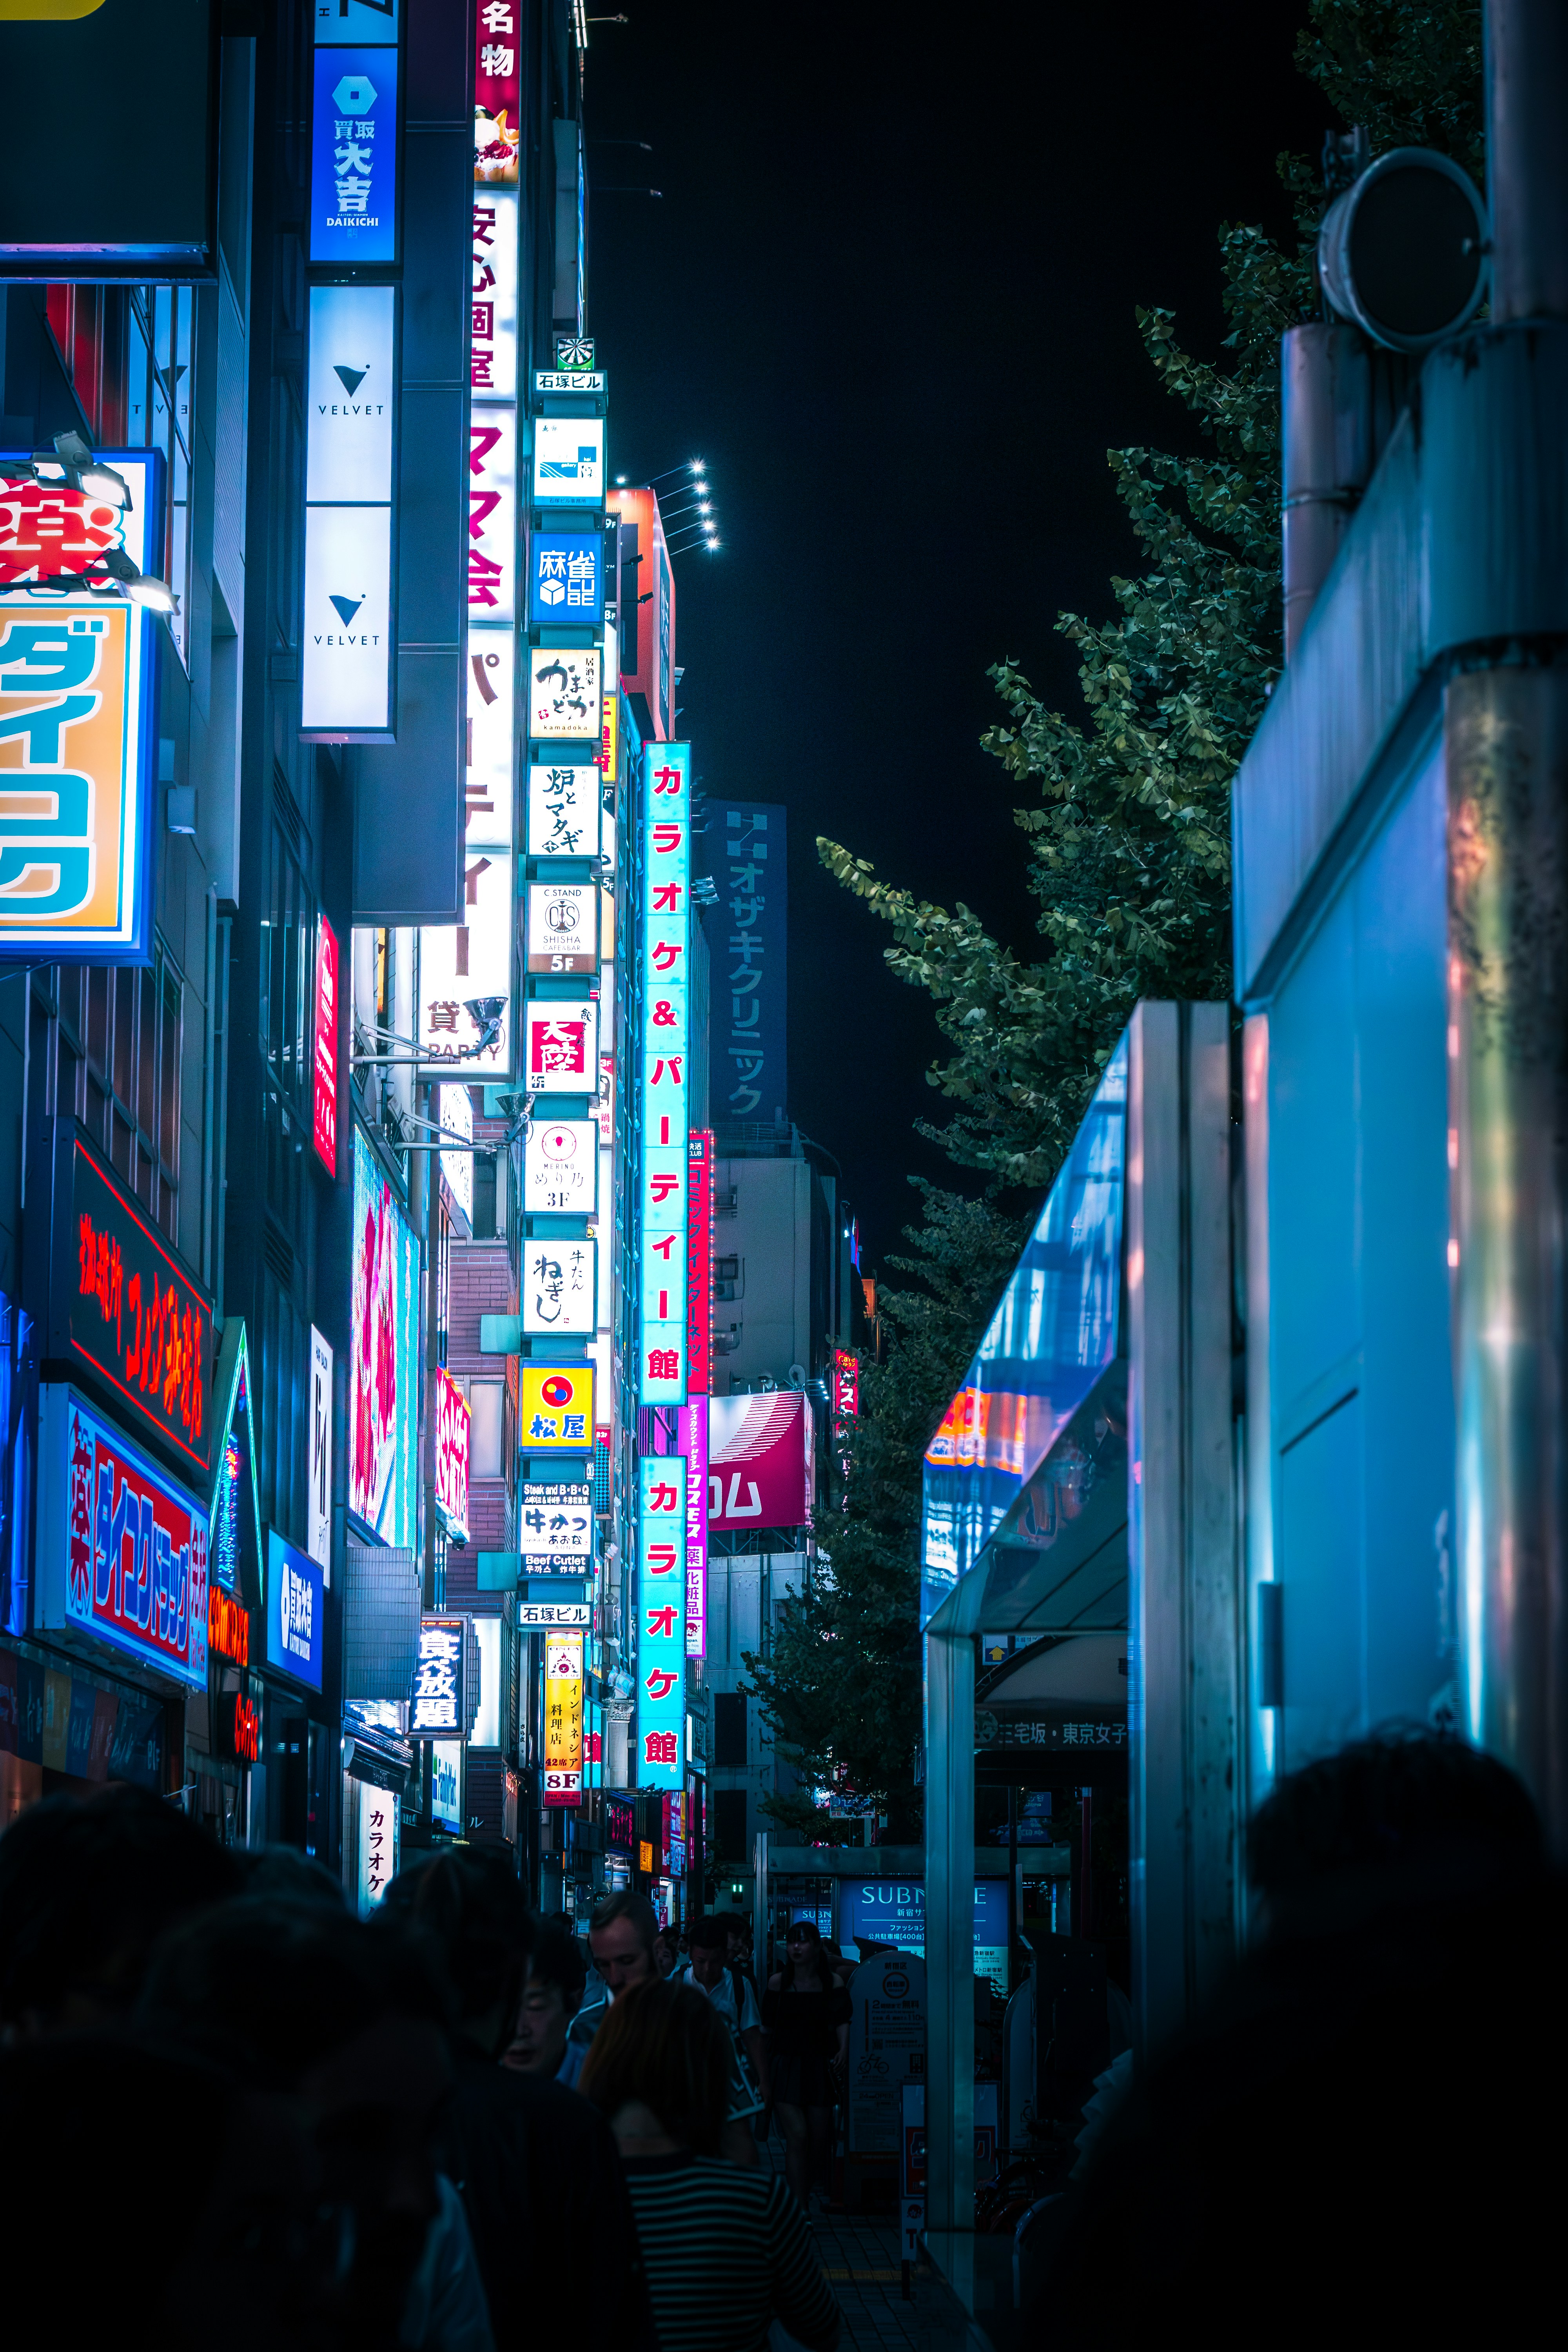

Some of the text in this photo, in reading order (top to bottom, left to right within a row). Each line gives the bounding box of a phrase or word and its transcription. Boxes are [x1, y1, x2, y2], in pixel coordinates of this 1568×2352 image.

[481, 1, 514, 76] 名物
[334, 120, 375, 139] 買取
[334, 141, 374, 212] 大吉
[327, 218, 379, 226] DAIKICHI
[539, 375, 601, 389] 石塚ビル
[318, 405, 384, 415] VELVET
[605, 518, 616, 528] 9F
[539, 550, 595, 579] 麻雀
[604, 610, 616, 620] 8F
[314, 635, 380, 645] VELVET
[542, 768, 583, 853] 炉とマタギ
[603, 877, 614, 891] 5F
[551, 955, 574, 971] 5F
[728, 862, 766, 1116] オザキクリニック
[540, 1021, 579, 1073] 大陸
[648, 765, 683, 1380] カラオケ&パーティー館
[535, 1172, 584, 1187] めり乃
[548, 1192, 570, 1207] 3F
[570, 1249, 584, 1290] 牛たん
[533, 1254, 564, 1323] ねぎし
[529, 1414, 586, 1439] 松屋
[524, 1484, 544, 1495] Steak
[546, 1485, 558, 1495] and
[687, 1474, 702, 1538] コスモス
[525, 1508, 587, 1534] 牛かつ
[549, 1535, 582, 1545] あおな
[95, 1459, 190, 1652] ダイコクドラッグ
[526, 1555, 586, 1565] Beef Cutlet
[687, 1548, 700, 1564] 薬
[687, 1572, 699, 1615] 化粧品
[523, 1607, 586, 1622] 石塚ビル
[644, 1482, 679, 1765] カラオケ館
[413, 1631, 460, 1729] 食べ放題
[550, 1704, 563, 1745] 料理店
[568, 1684, 580, 1768] インドネシア
[437, 1758, 457, 1812] FamilyMart
[547, 1773, 580, 1788] 8F
[367, 1810, 385, 1922] カラオケ
